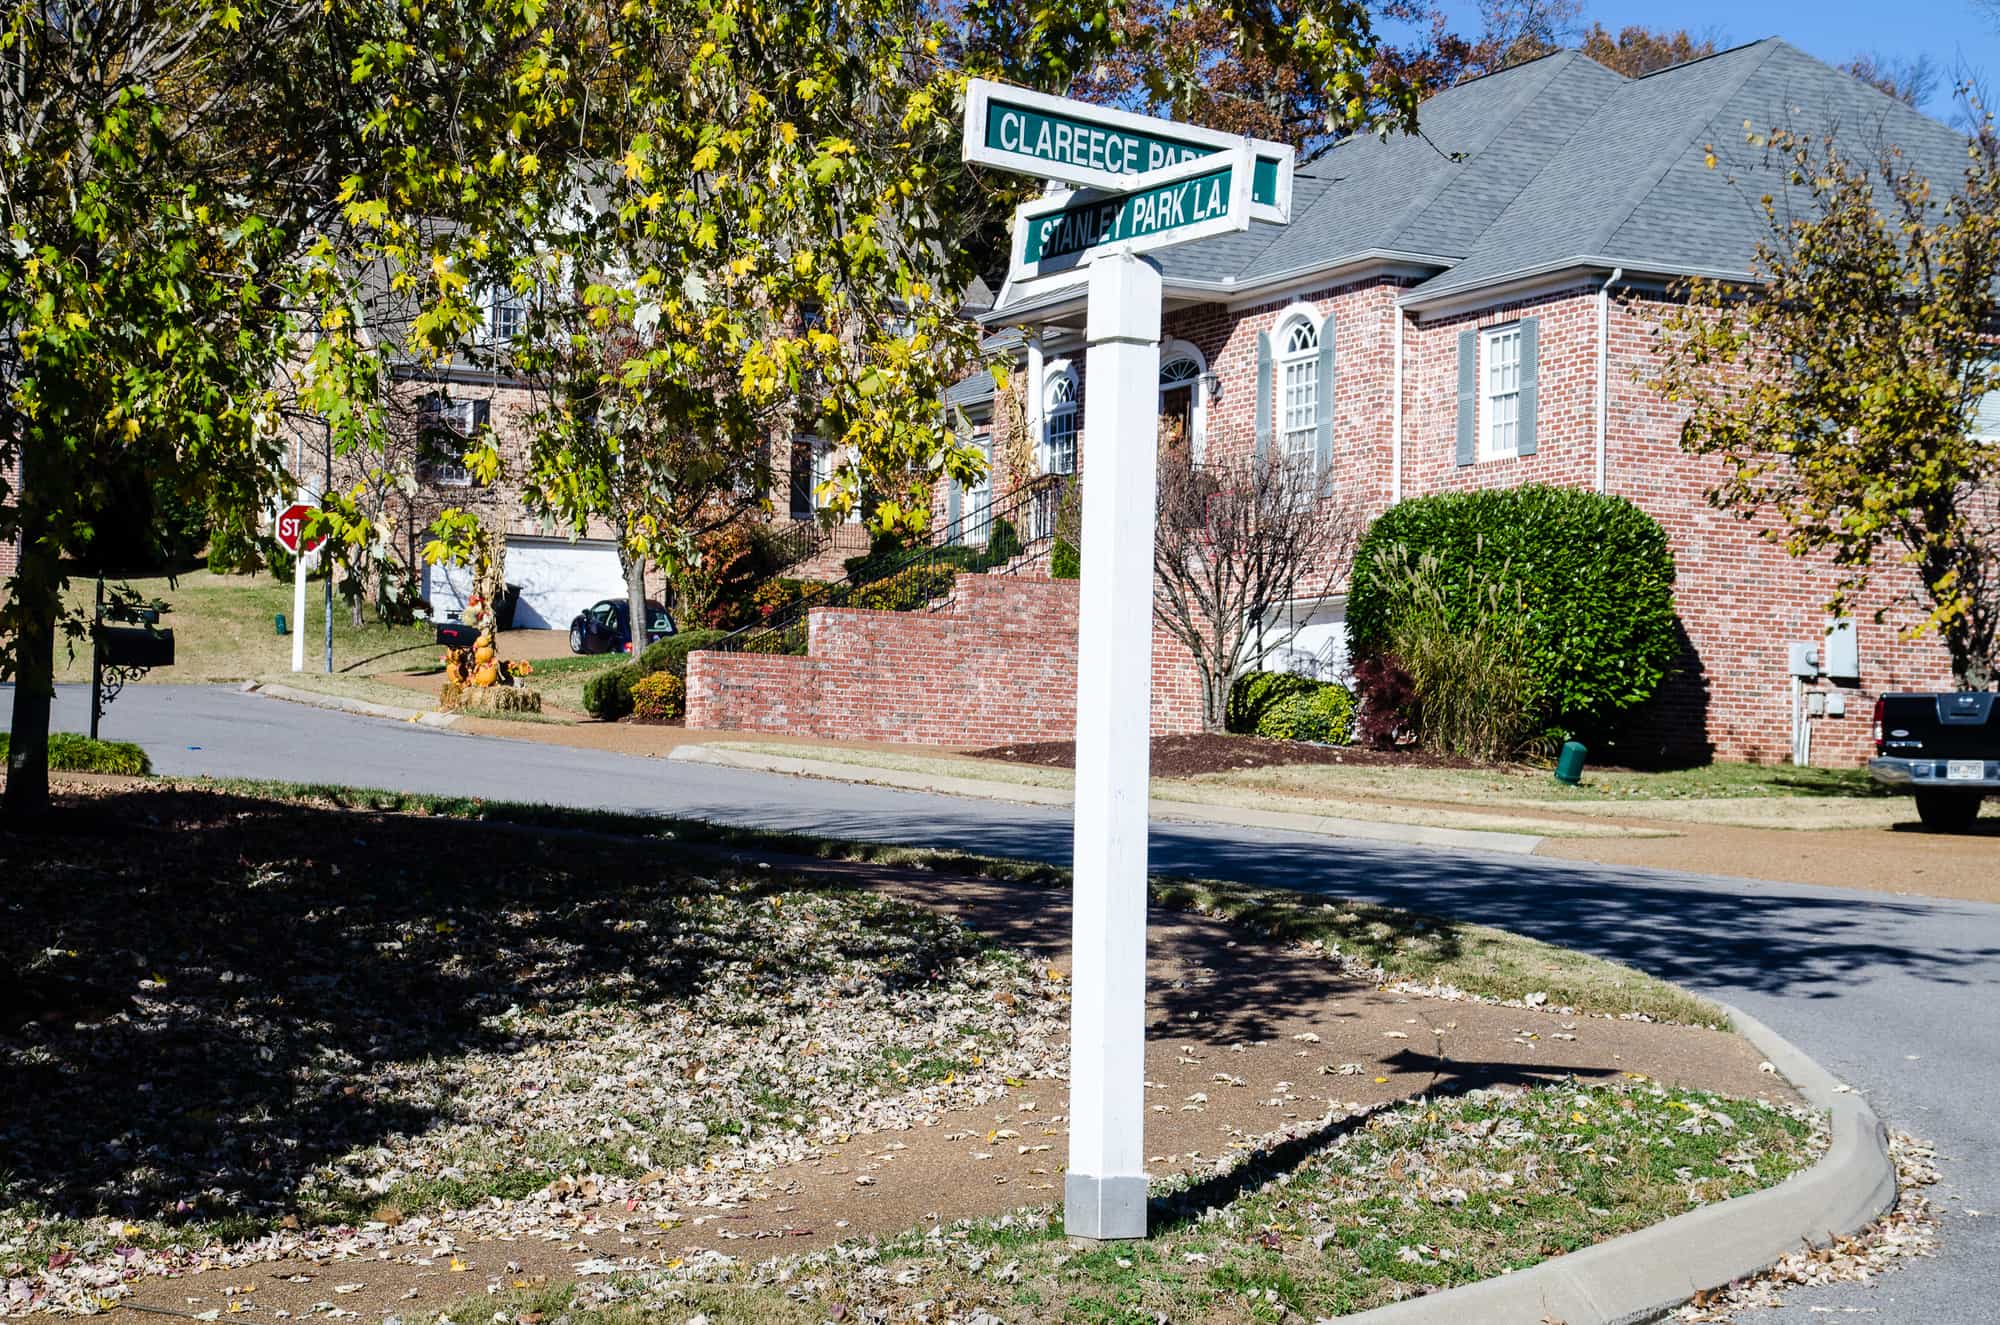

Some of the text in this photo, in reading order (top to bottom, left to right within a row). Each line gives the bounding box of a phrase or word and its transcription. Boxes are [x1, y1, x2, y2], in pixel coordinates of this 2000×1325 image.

[1000, 112, 1204, 174] CLAREECE PA
[1038, 178, 1227, 257] STANLEY PARK LA.
[281, 518, 301, 537] ST
